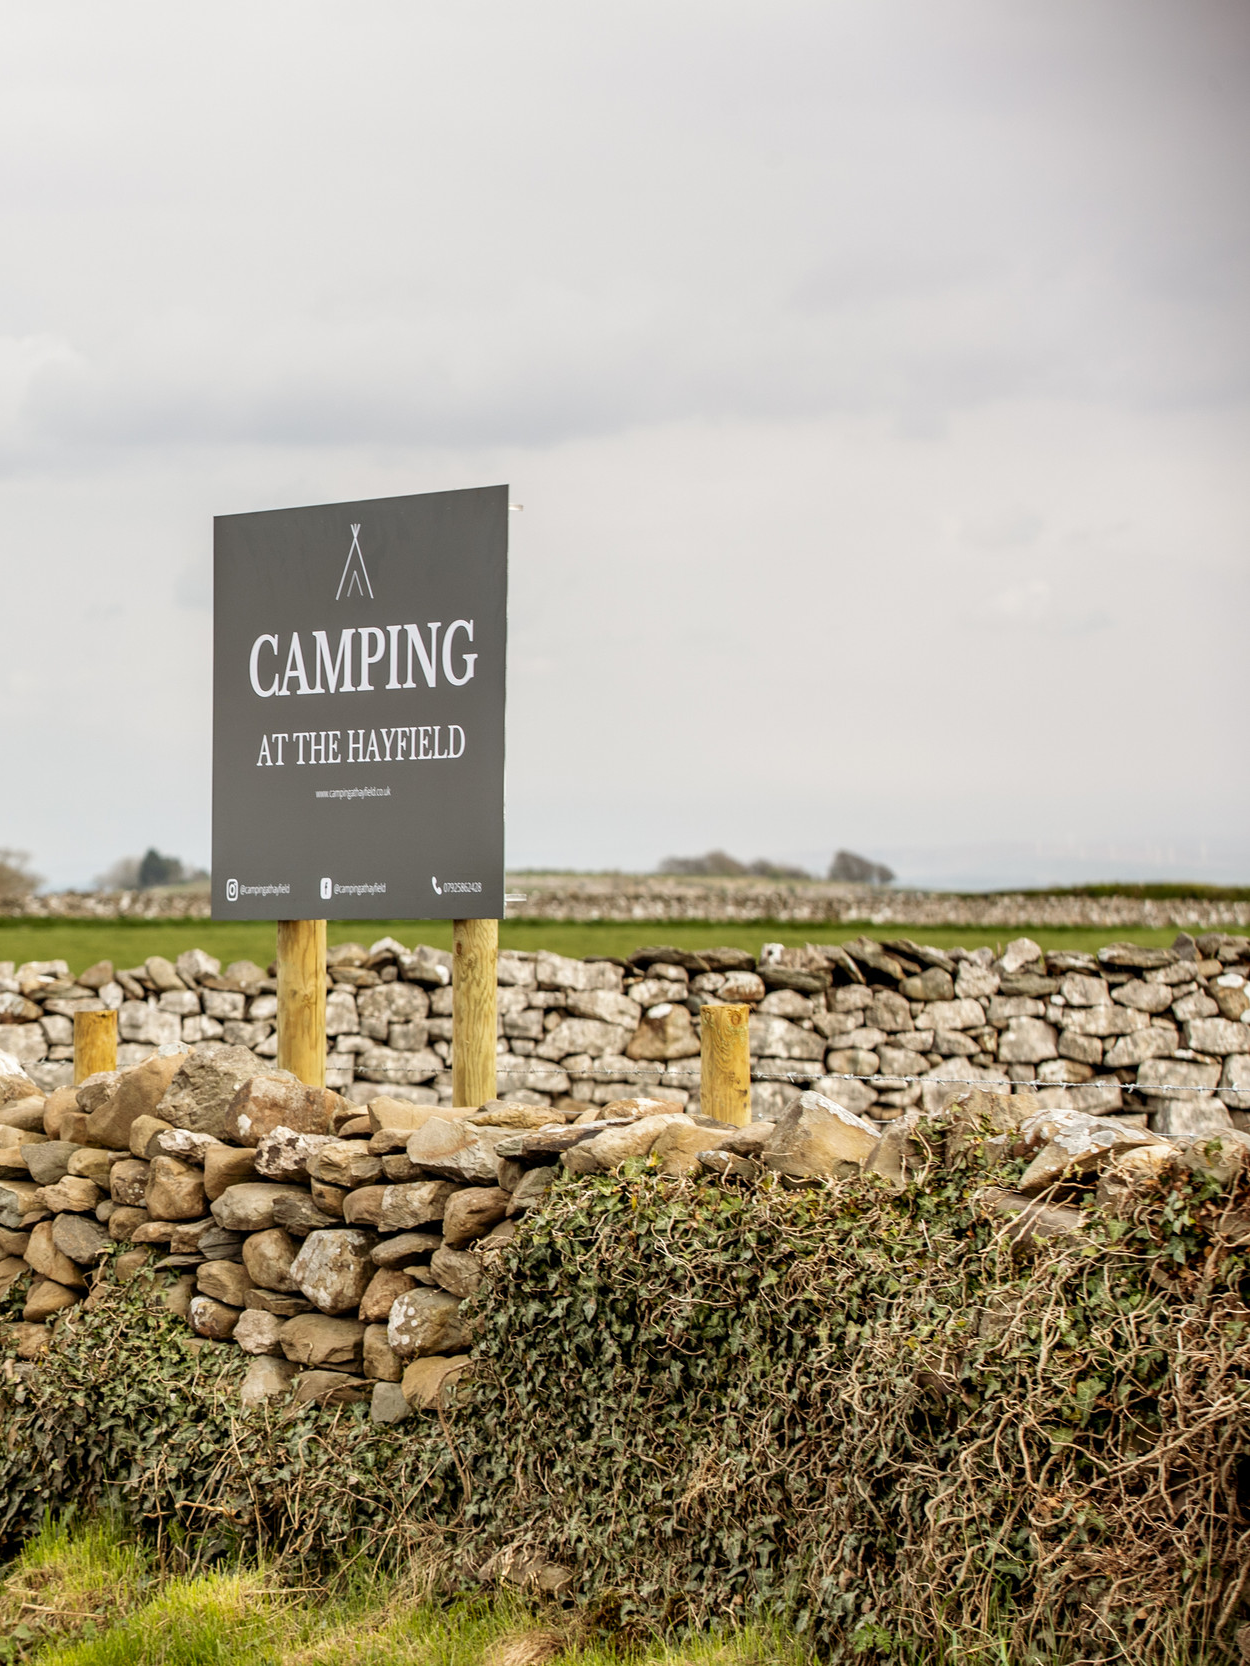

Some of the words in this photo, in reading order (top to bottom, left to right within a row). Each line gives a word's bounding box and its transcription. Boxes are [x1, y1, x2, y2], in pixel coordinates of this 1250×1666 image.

[249, 619, 479, 698] CAMPING
[257, 734, 289, 766] AT
[293, 730, 342, 764] THE
[347, 724, 466, 762] HAYFIELD
[315, 785, 392, 801] www.campingathayfield.co.uk
[240, 883, 291, 897] @campingathayfield
[333, 882, 387, 897] @campingathayfield
